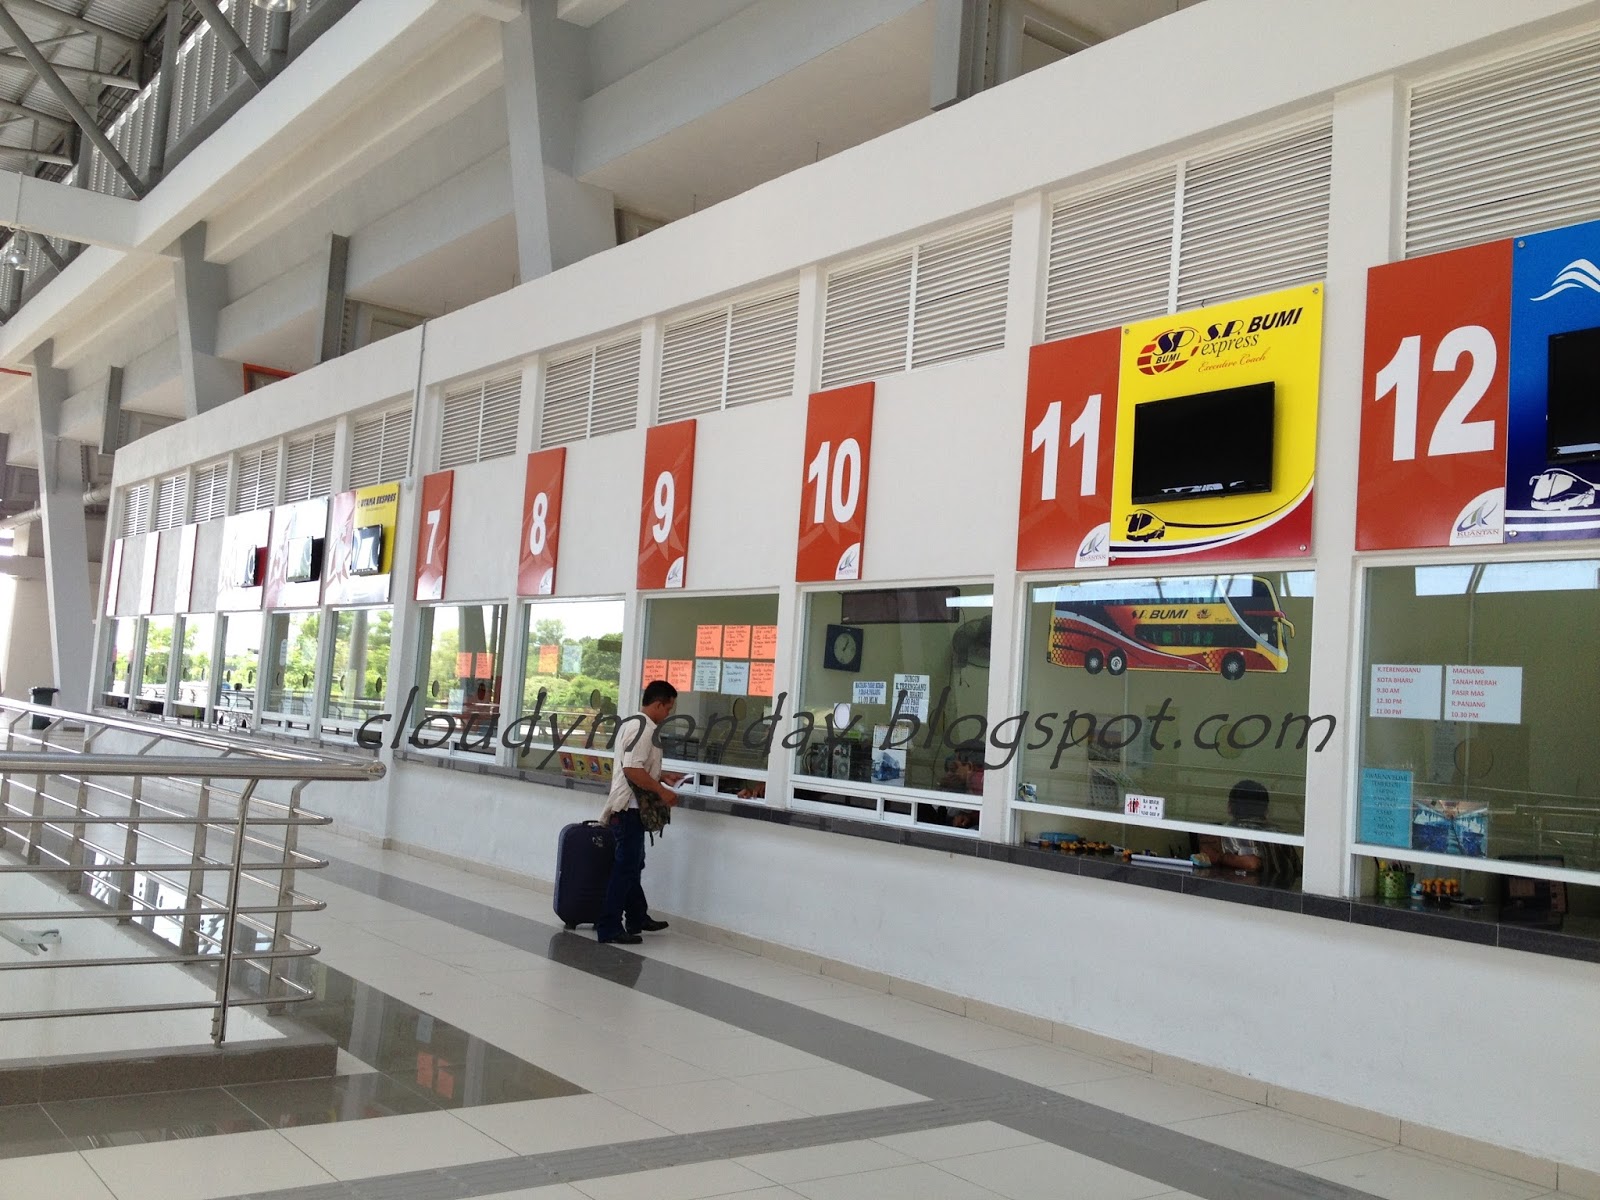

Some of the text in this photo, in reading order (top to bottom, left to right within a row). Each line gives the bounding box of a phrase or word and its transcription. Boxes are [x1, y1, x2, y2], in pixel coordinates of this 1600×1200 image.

[1201, 333, 1259, 358] express
[1247, 307, 1303, 333] BUMI
[1155, 352, 1181, 364] BUMI
[1198, 347, 1272, 373] Executive Coach
[1374, 325, 1498, 462] 12
[1031, 393, 1102, 500] 11
[652, 471, 676, 544] 9
[807, 437, 861, 525] 10
[426, 509, 442, 565] 7
[529, 492, 548, 556] 8
[1149, 609, 1189, 619] BUMI
